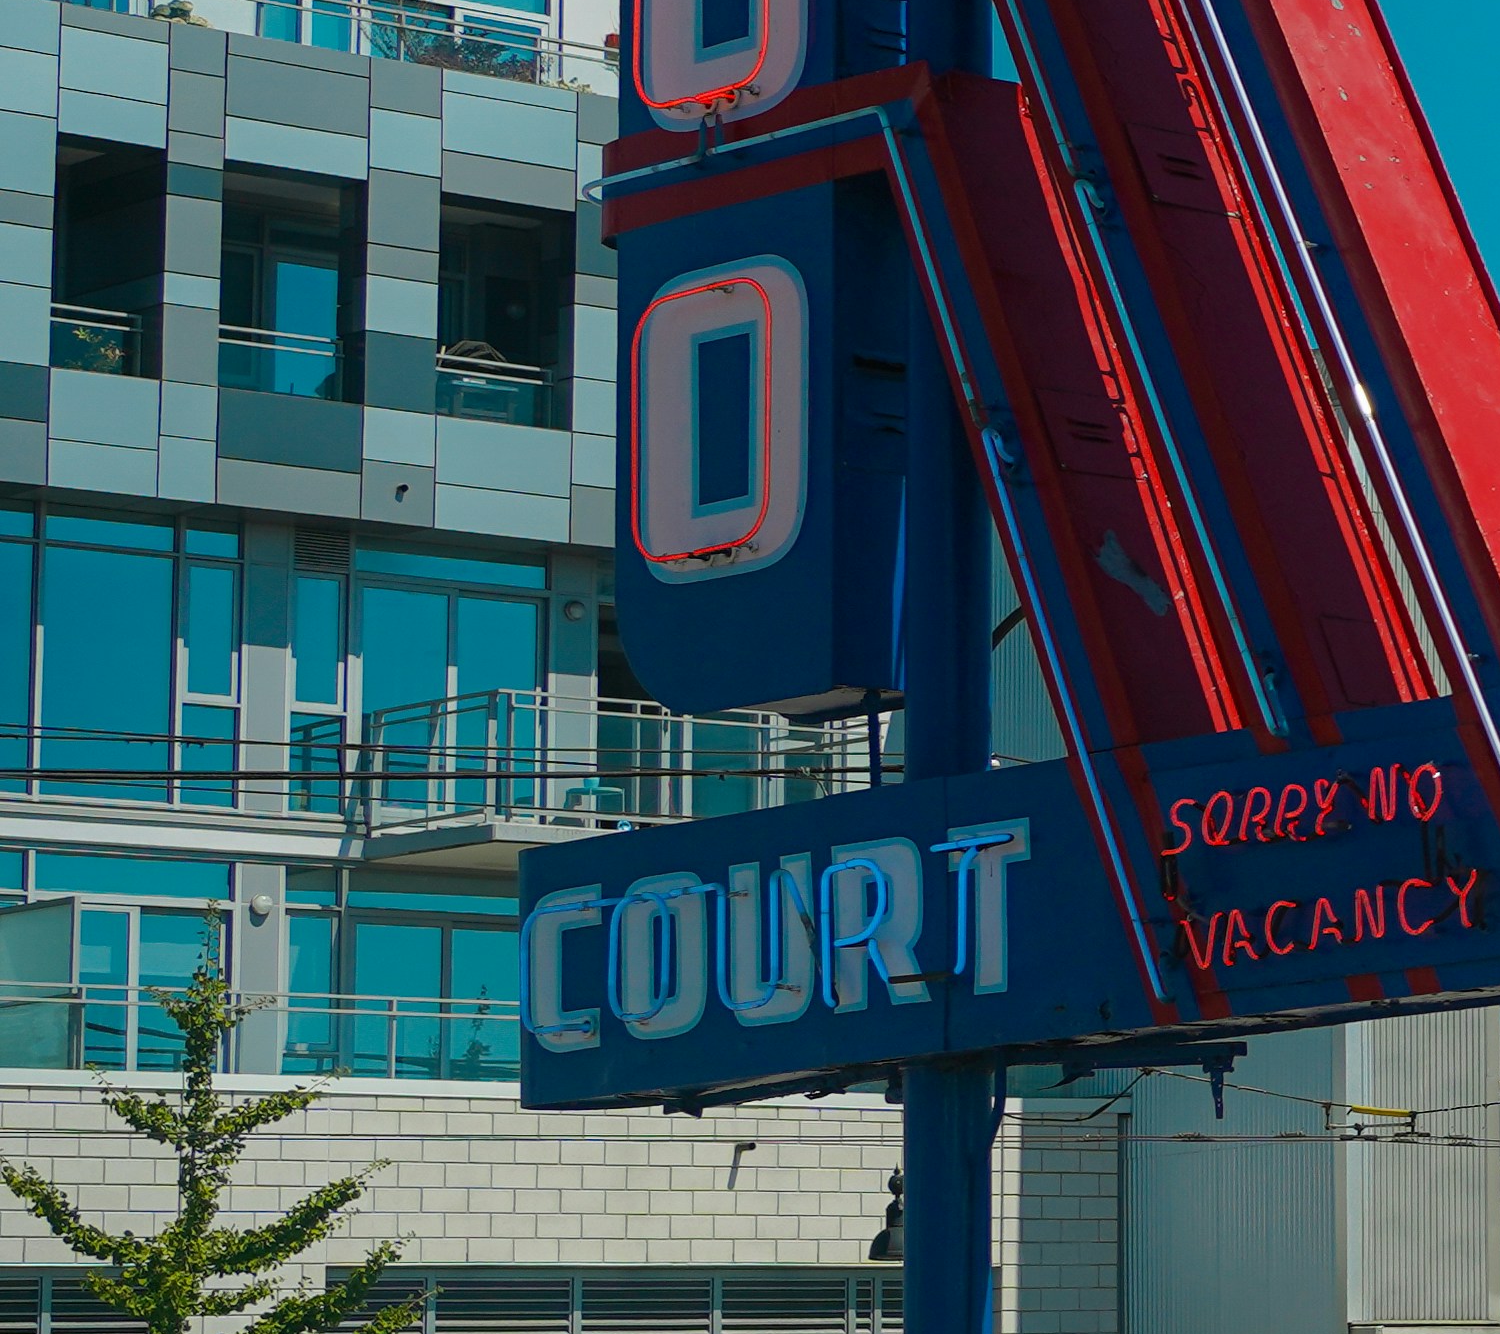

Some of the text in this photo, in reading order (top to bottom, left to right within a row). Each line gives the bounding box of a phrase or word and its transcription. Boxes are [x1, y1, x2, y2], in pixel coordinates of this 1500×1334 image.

[1162, 760, 1444, 858] SORRY NO
[520, 816, 1031, 1054] COURT
[1180, 868, 1481, 971] VACANCY
